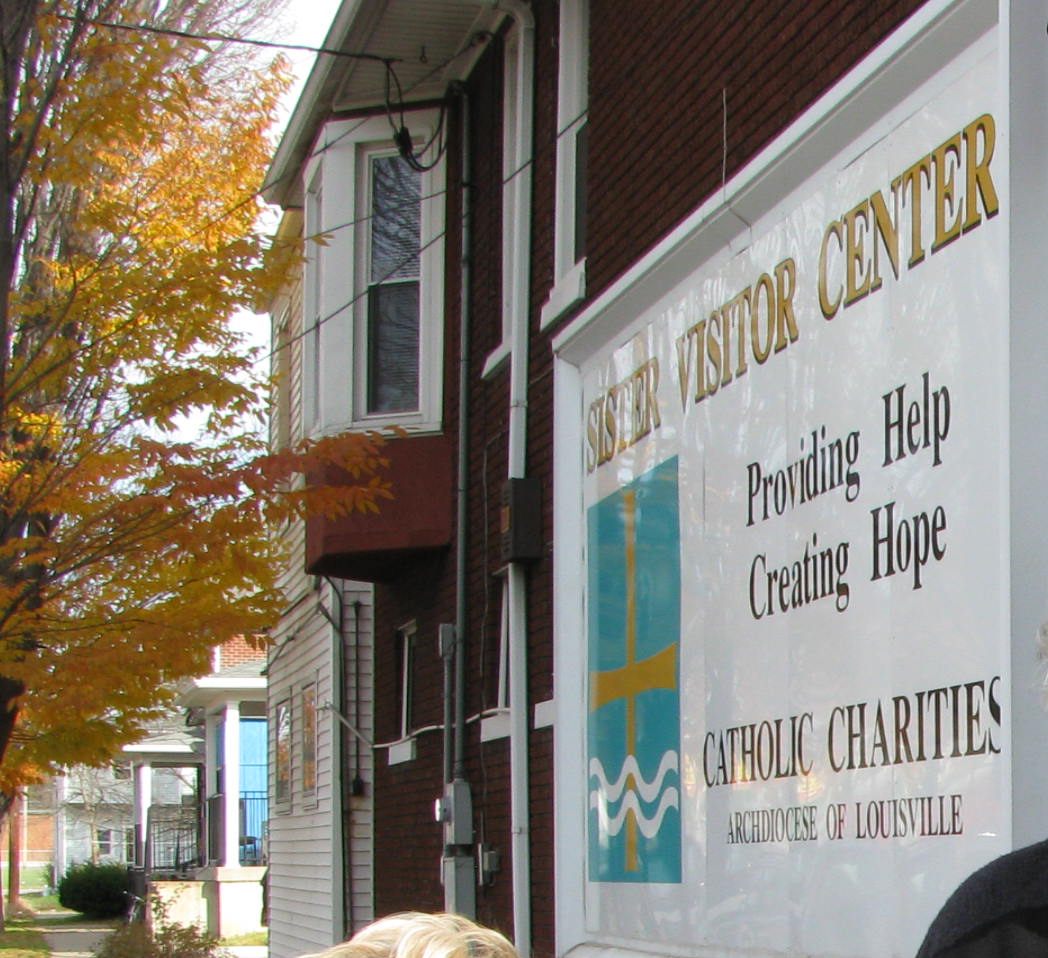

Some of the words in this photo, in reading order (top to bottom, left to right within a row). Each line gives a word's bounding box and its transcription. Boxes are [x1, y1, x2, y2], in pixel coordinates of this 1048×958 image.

[586, 357, 661, 474] SISTER
[676, 258, 799, 412] VISITOR
[818, 113, 999, 320] CENTER
[746, 425, 860, 526] Providing
[882, 372, 951, 467] Help
[749, 532, 850, 620] Creating
[870, 502, 947, 590] Hope
[703, 711, 815, 788] CATHOLIC
[828, 676, 1001, 772] CHARITIES
[727, 805, 818, 844] ARCHDIOCESE
[826, 803, 847, 841] OF
[855, 795, 963, 840] LOUISVILLE
